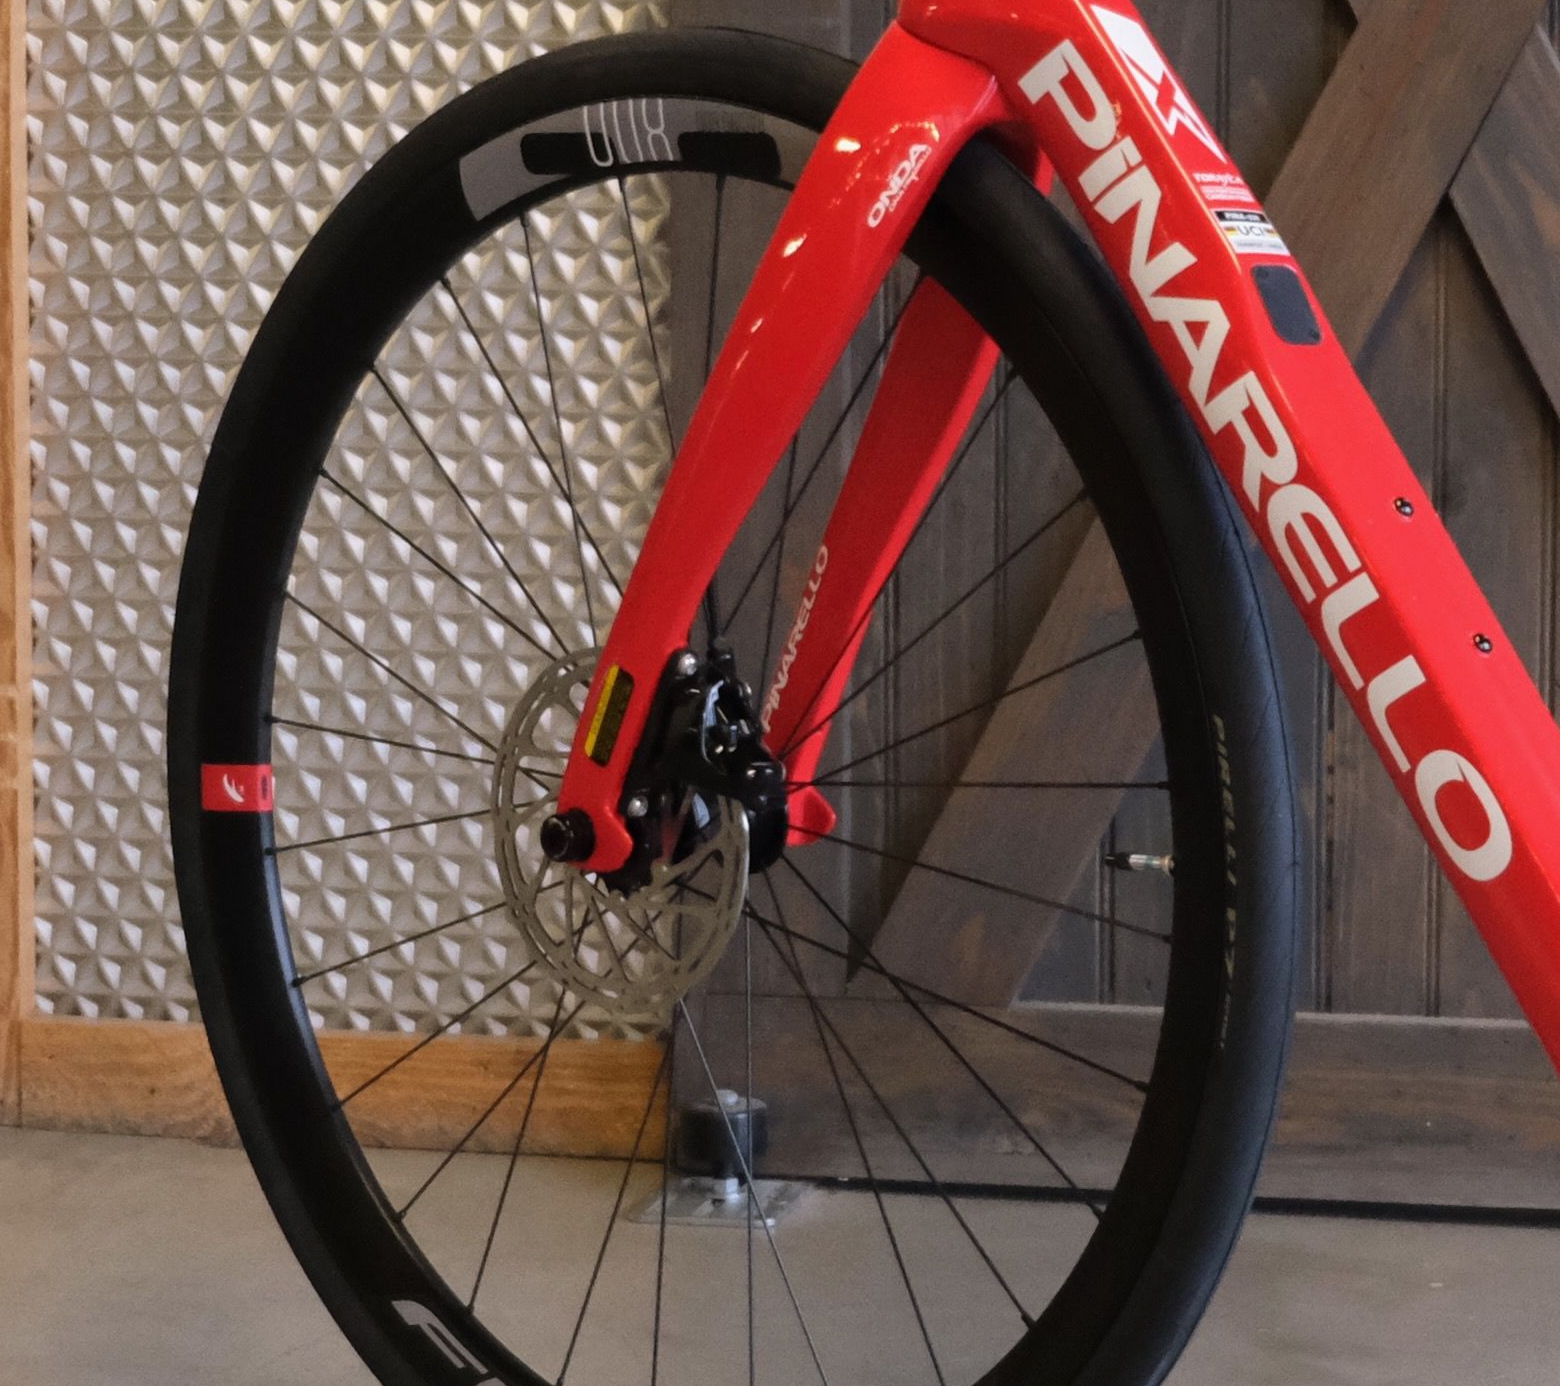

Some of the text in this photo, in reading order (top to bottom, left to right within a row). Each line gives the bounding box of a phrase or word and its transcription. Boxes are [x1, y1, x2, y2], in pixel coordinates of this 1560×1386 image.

[867, 143, 929, 227] ONDA
[1238, 225, 1265, 237] UCI
[1019, 38, 1513, 882] PINARELLO
[762, 545, 829, 732] PINARELLO
